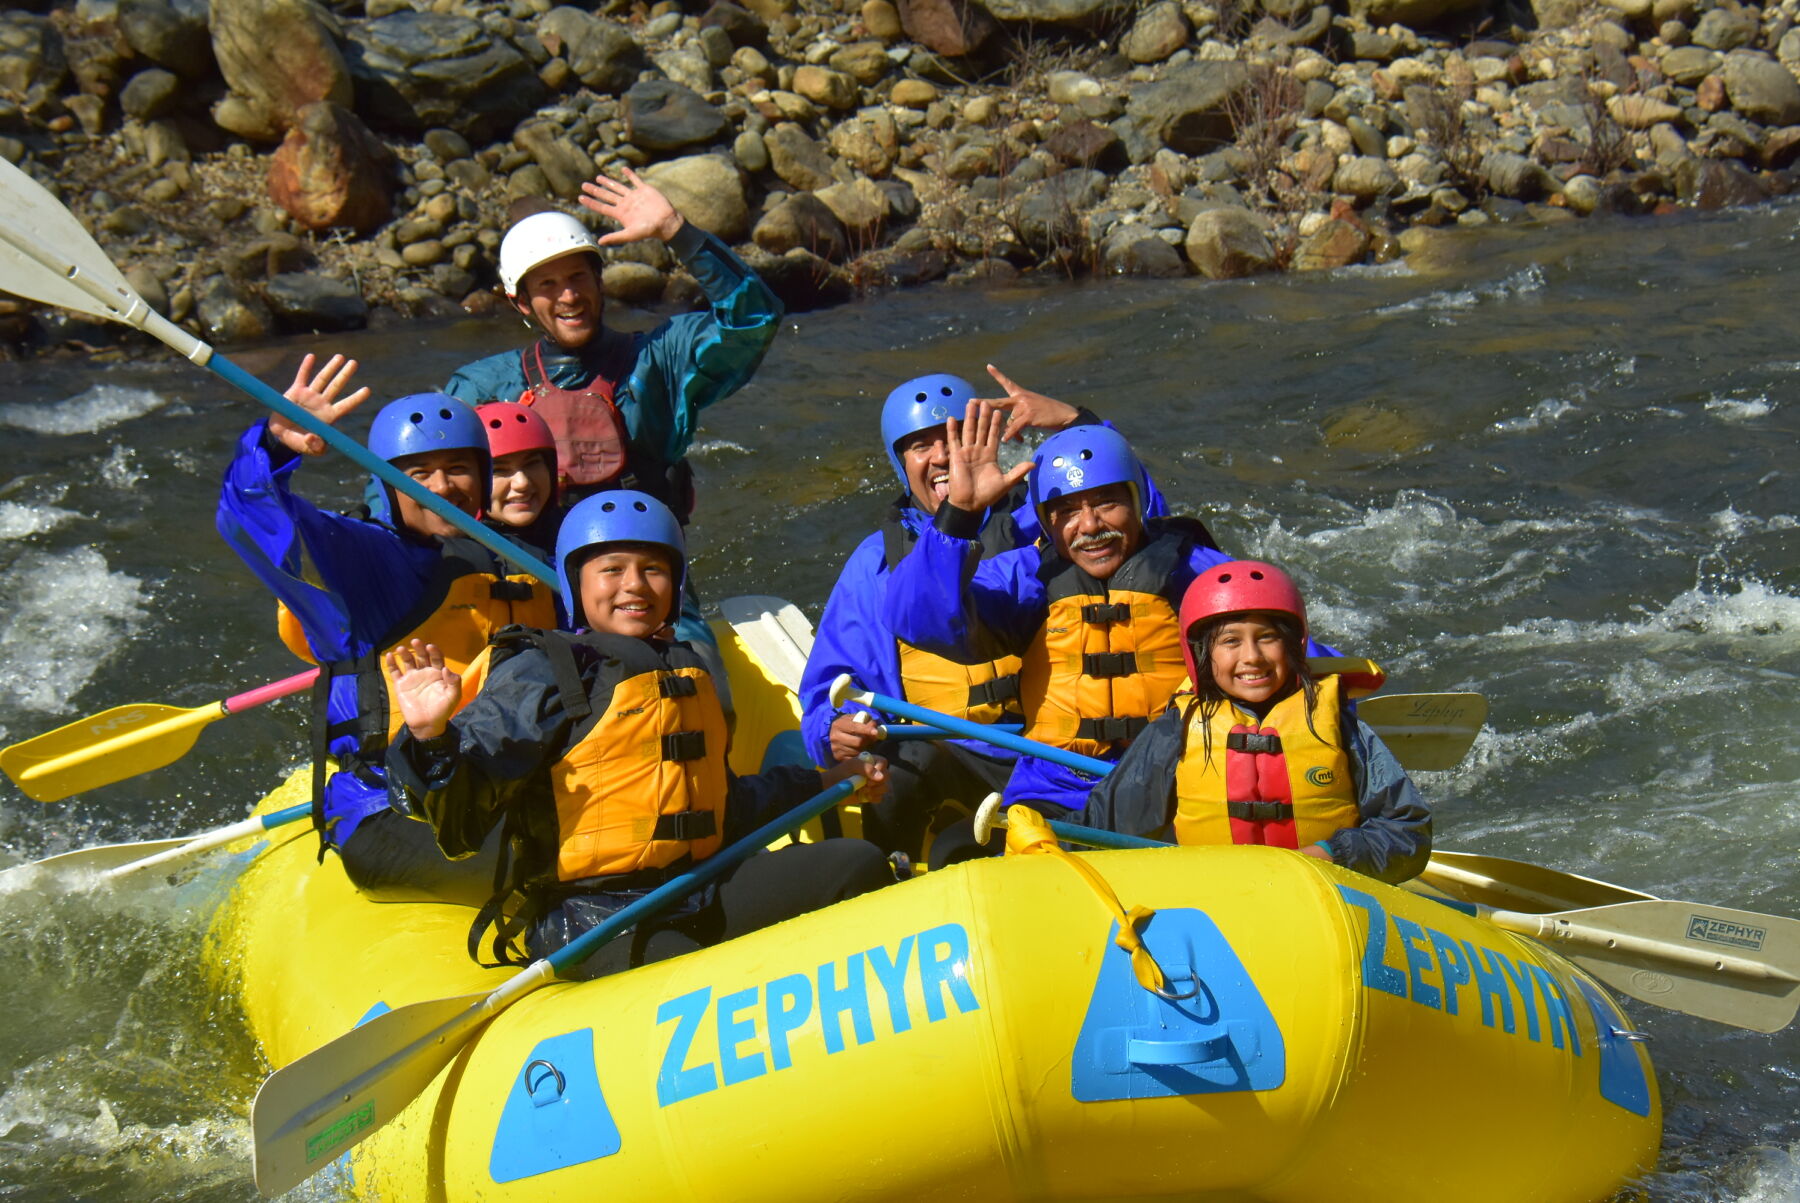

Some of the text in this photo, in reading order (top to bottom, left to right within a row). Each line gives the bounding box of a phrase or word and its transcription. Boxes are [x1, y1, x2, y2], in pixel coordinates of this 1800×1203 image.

[89, 709, 148, 736] NRS
[617, 707, 645, 719] NRS
[1407, 698, 1465, 726] Zephyr
[1709, 921, 1764, 941] ZEPHYR
[1334, 882, 1583, 1059] ZEPHYR
[655, 922, 981, 1109] ZEPHYR
